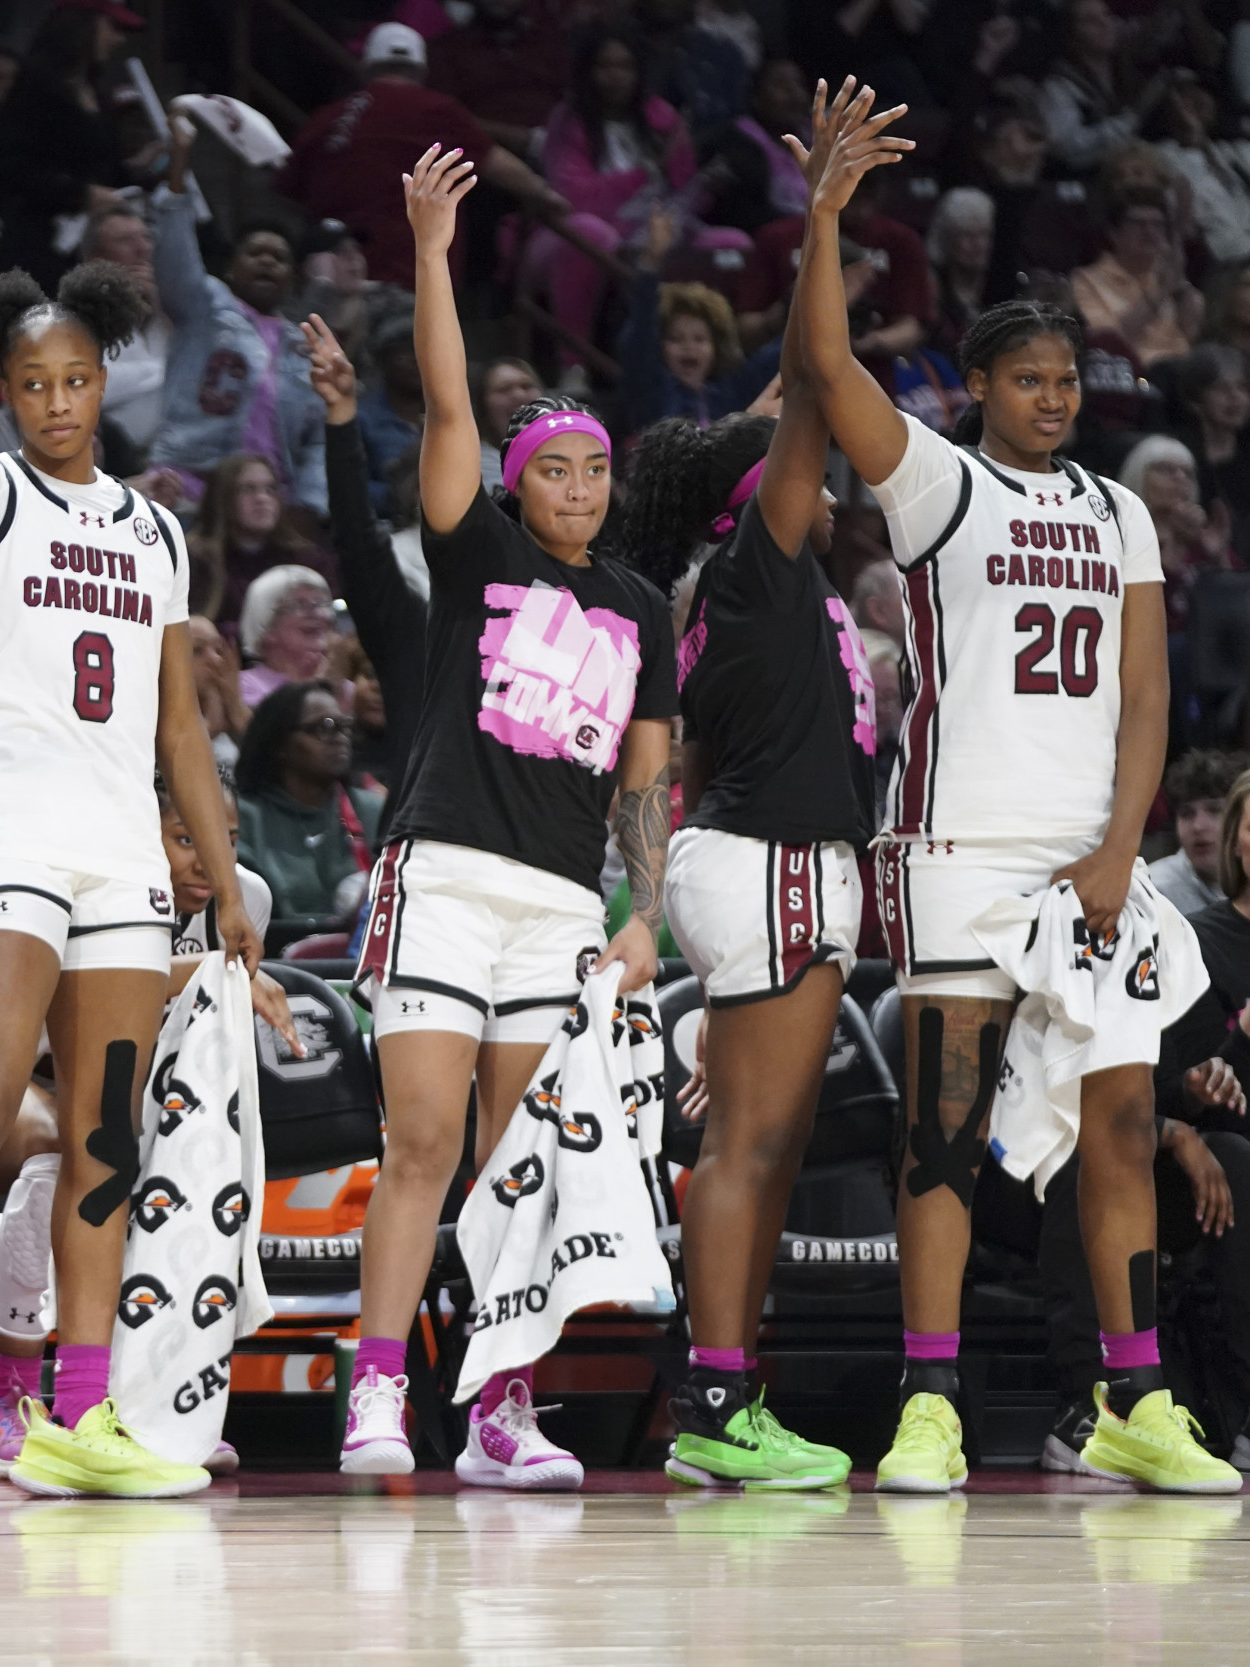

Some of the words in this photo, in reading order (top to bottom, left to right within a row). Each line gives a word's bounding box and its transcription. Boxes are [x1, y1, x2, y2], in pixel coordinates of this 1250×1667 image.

[50, 540, 137, 584] SOUTH
[1009, 519, 1101, 554] SOUTH
[23, 576, 153, 628] CAROLINA
[986, 554, 1120, 598] CAROLINA
[1014, 603, 1104, 697] 20
[72, 630, 114, 723] 8
[788, 852, 806, 943] USC
[885, 861, 897, 923] SC
[261, 1238, 362, 1259] GAMECO
[792, 1240, 900, 1261] GAMECO
[474, 1231, 617, 1332] GATOADE
